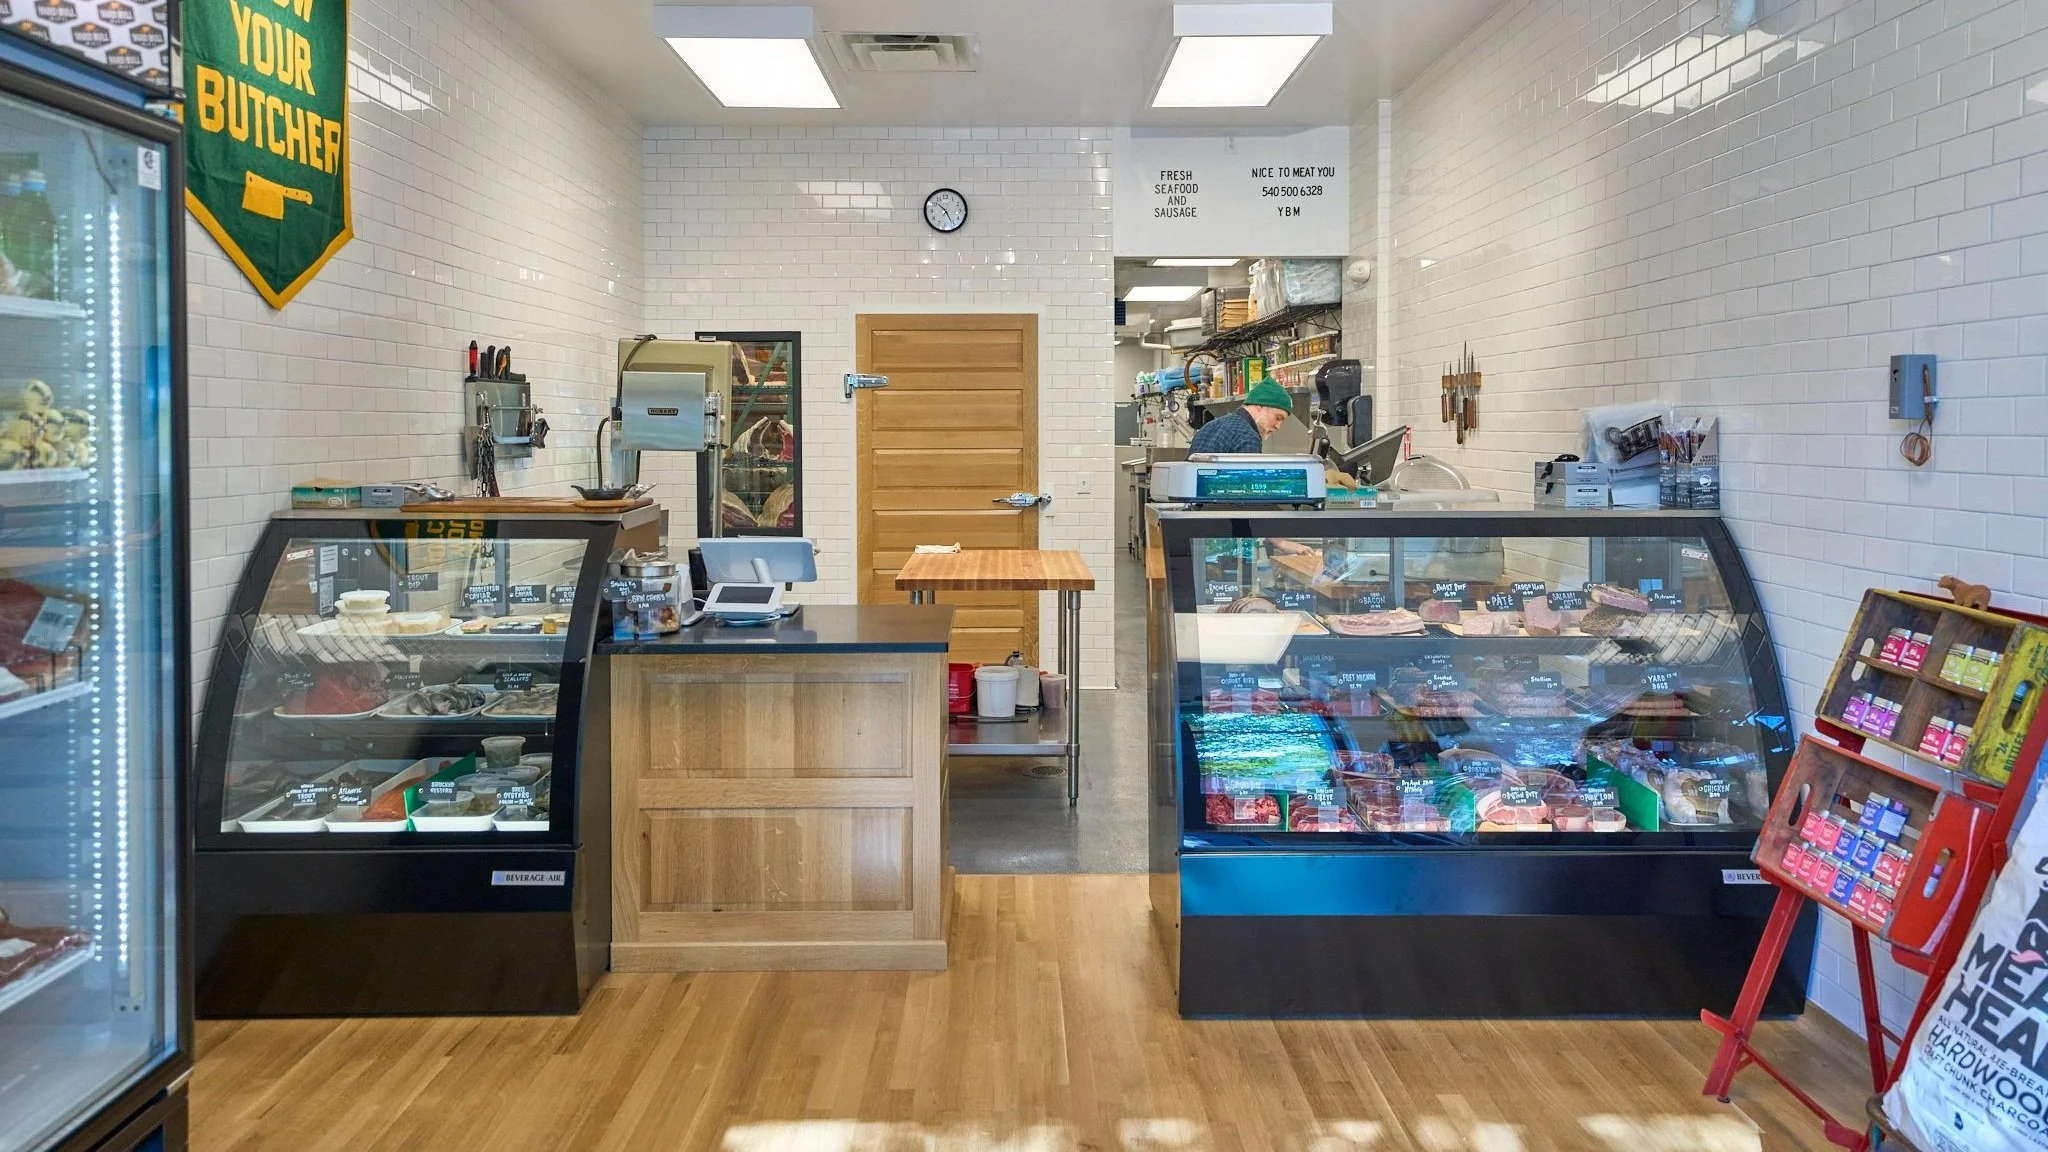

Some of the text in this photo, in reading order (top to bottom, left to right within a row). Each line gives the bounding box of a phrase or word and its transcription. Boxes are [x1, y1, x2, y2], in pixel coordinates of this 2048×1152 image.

[230, 0, 315, 96] YOUR
[197, 64, 341, 176] BUTCHER
[1160, 170, 1192, 180] FRESH
[1252, 167, 1335, 178] NICE TO MEAT YOU
[1154, 184, 1198, 194] SEAFOOD
[1262, 186, 1322, 196] 540 500 6328
[1168, 196, 1186, 205] AND
[1154, 208, 1197, 218] SAUSAGE
[1364, 596, 1386, 604] BACON
[1492, 595, 1514, 606] PÂTÉ
[1552, 592, 1576, 600] SALAMI
[1342, 673, 1355, 682] FILET
[1648, 674, 1665, 682] YARD
[2003, 734, 2026, 772] BOTTLES
[1704, 784, 1730, 793] CHICKEN
[1938, 1015, 1953, 1031] ALL
[1953, 1026, 1988, 1057] NATURAL
[1944, 1062, 1980, 1093] CHUNK
